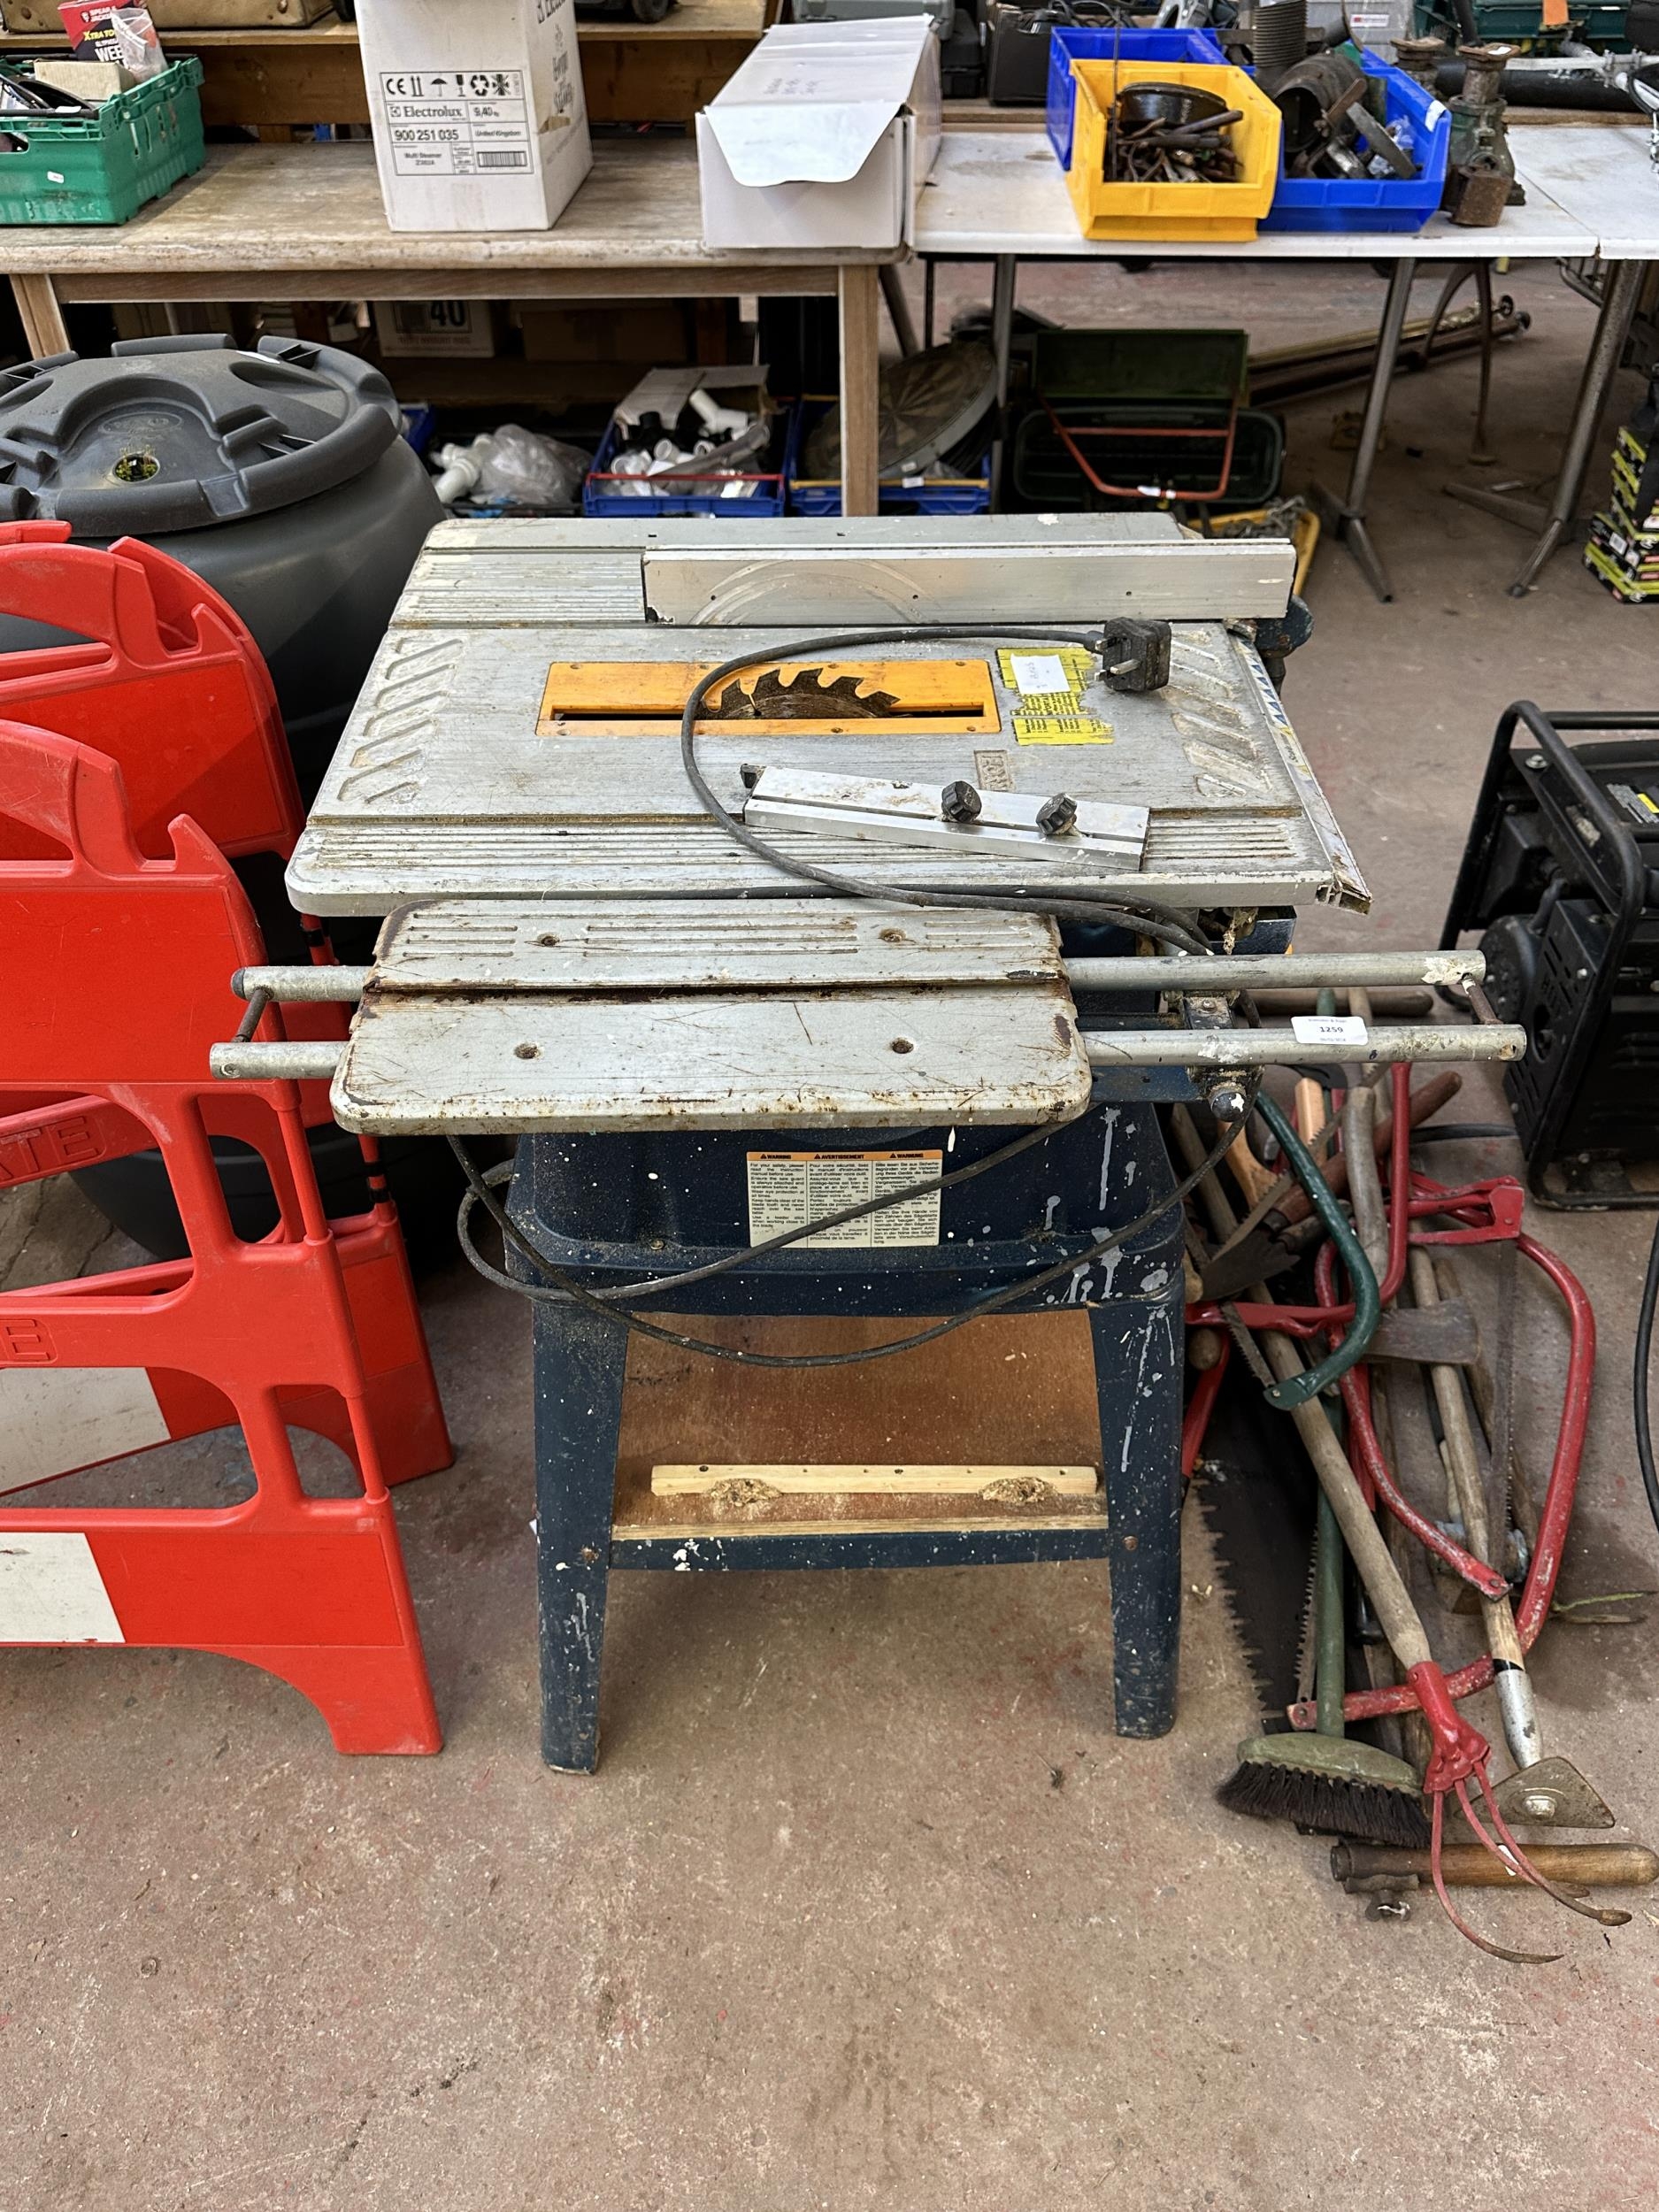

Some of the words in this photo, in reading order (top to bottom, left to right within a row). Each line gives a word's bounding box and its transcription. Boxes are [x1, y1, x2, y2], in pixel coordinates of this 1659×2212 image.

[403, 105, 462, 118] Electrolux
[395, 129, 415, 141] 900
[417, 129, 436, 141] 251
[438, 128, 459, 141] 035
